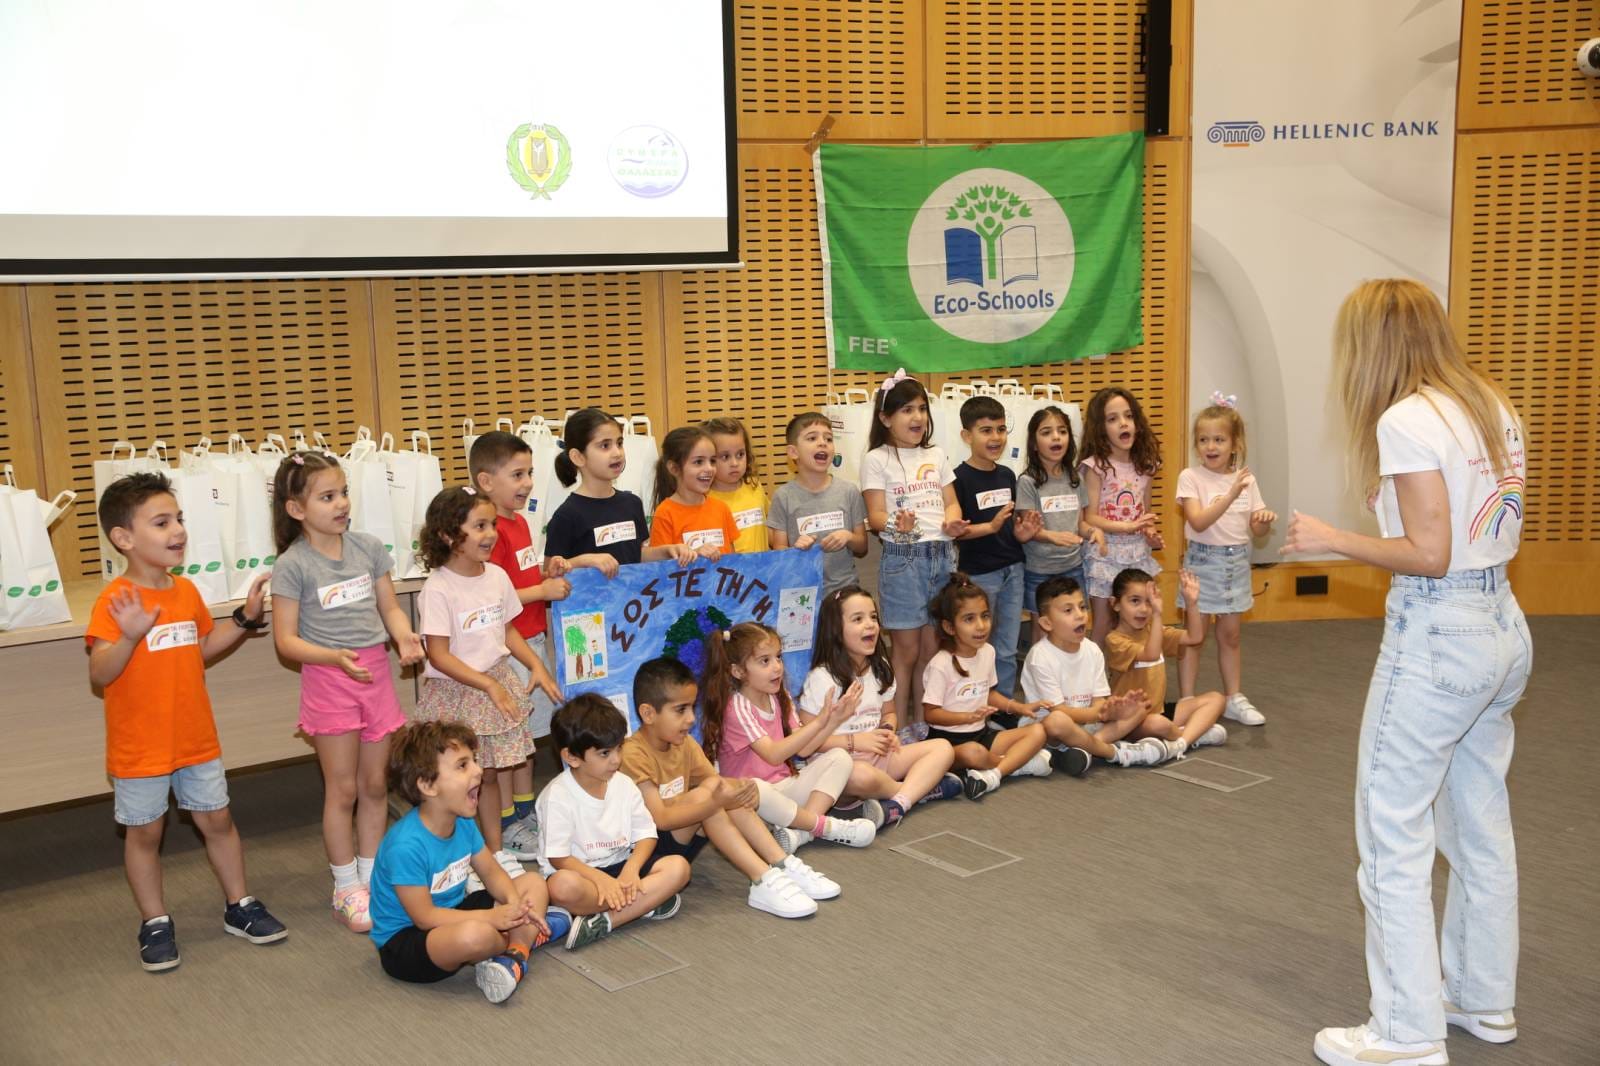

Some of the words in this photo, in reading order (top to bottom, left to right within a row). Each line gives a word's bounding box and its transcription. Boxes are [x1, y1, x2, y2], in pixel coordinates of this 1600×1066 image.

[1273, 122, 1374, 140] HELLENIC
[1383, 120, 1439, 137] BANK
[934, 288, 1055, 314] Eco-Schools
[848, 336, 889, 355] FEE
